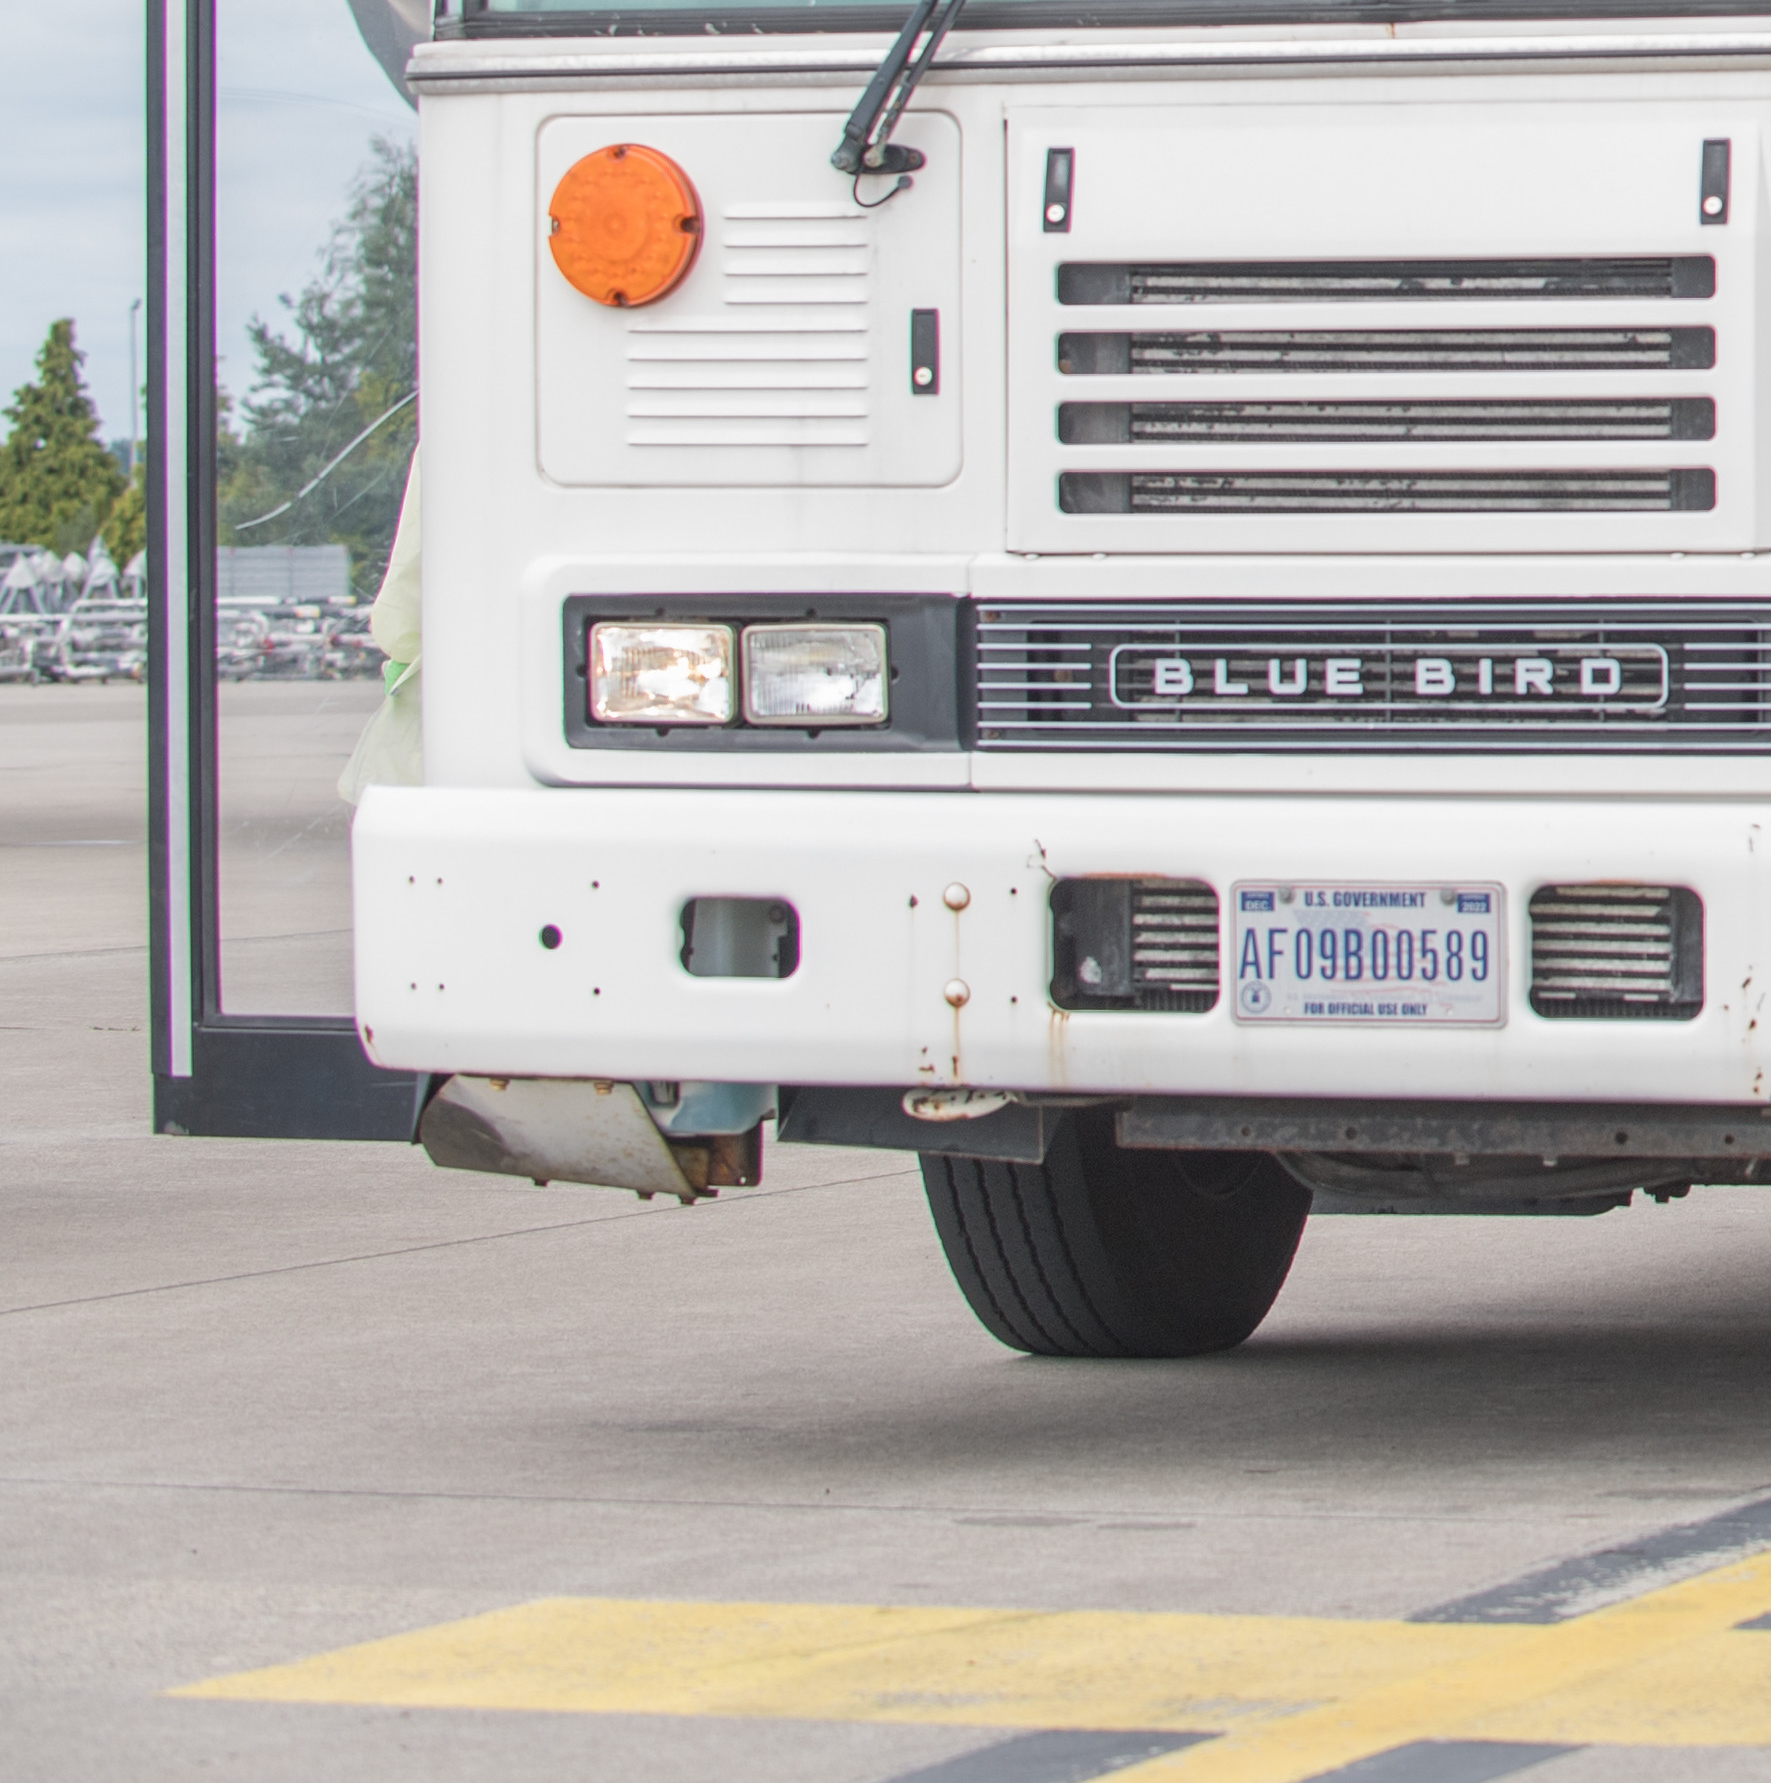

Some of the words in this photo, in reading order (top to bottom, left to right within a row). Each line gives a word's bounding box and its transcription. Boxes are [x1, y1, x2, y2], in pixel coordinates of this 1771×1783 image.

[1154, 658, 1364, 695] BLUE
[1415, 658, 1622, 695] BIRD
[1304, 891, 1330, 907] U.S.
[1333, 891, 1426, 908] GOVERNMENT
[1239, 927, 1489, 981] AF09B00589
[1304, 1002, 1325, 1016] FOR
[1328, 1002, 1374, 1016] OFFICIAL
[1378, 1002, 1397, 1016] USE
[1401, 1002, 1428, 1016] ONLY
